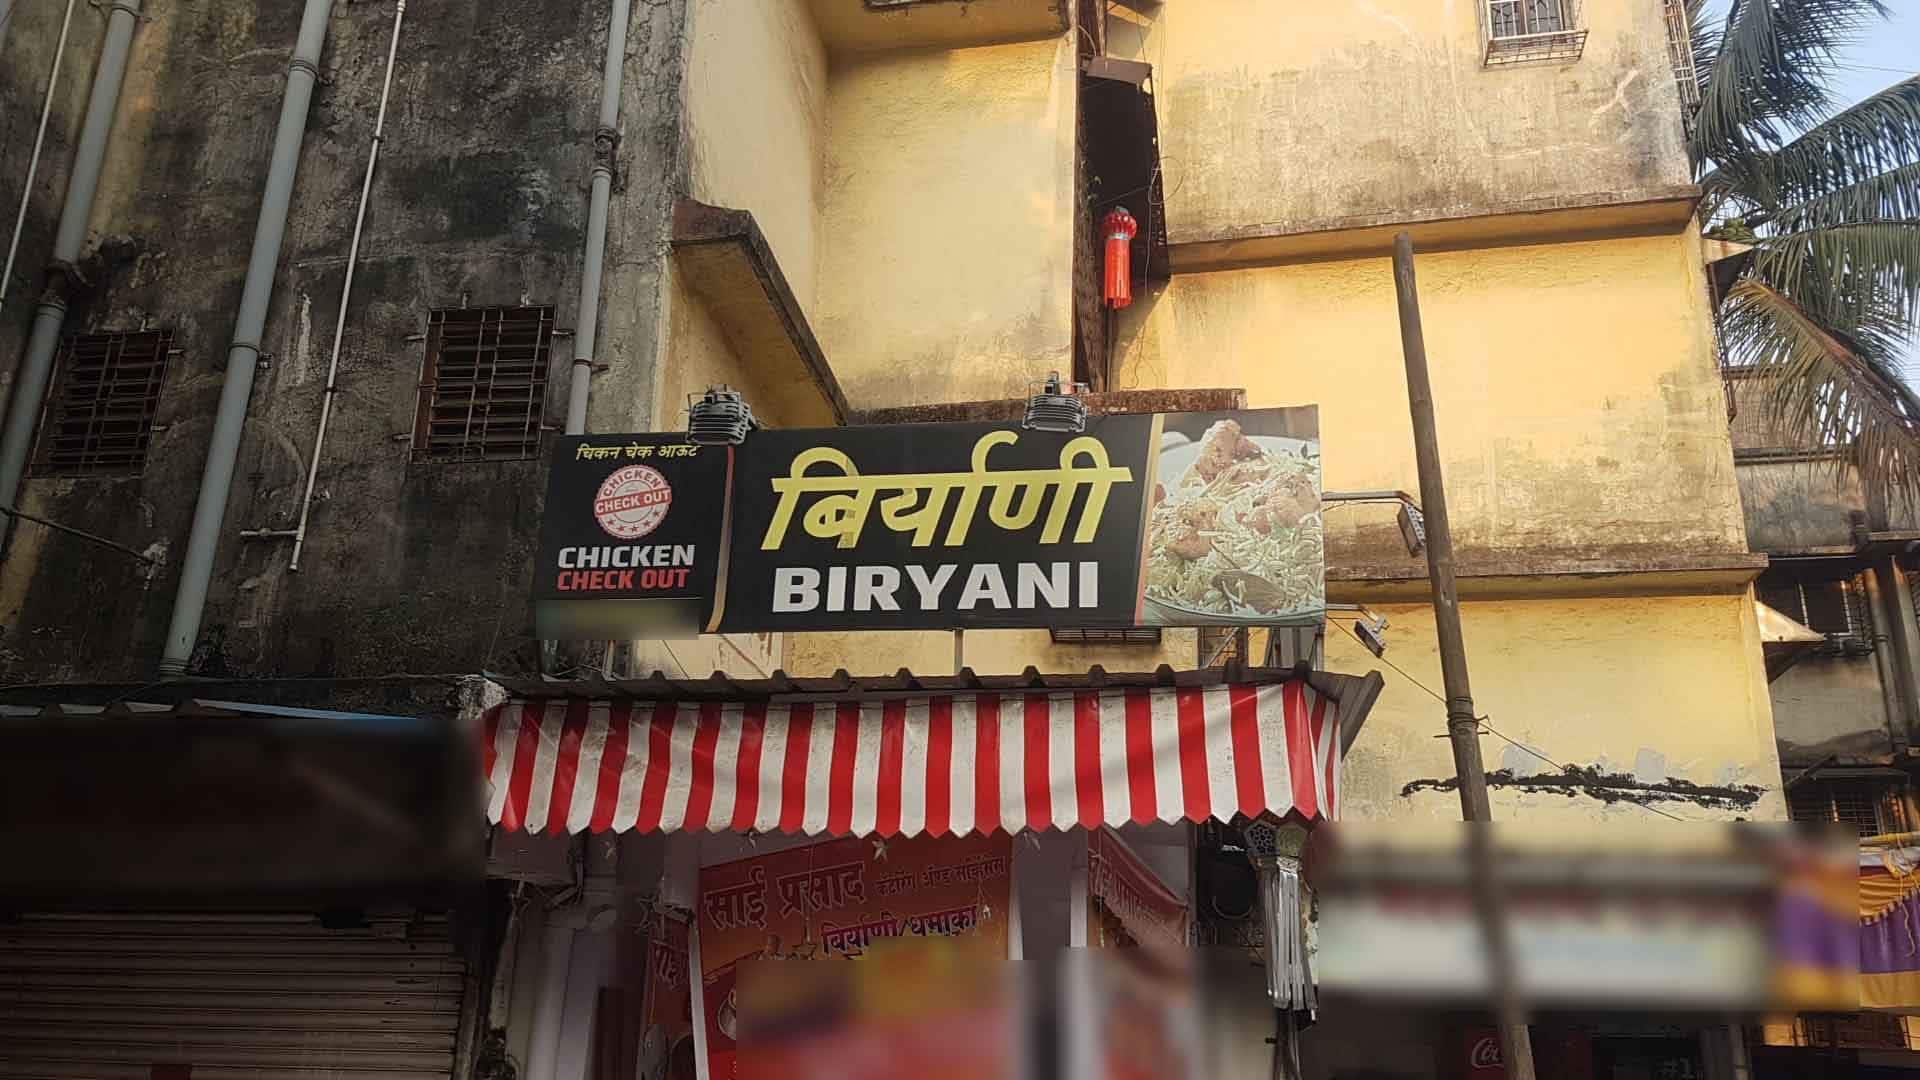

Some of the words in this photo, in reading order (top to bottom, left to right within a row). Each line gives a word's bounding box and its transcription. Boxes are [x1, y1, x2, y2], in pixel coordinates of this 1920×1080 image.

[576, 443, 622, 461] चिकन
[625, 441, 655, 459] चेक
[603, 470, 662, 497] CHICKEN
[761, 430, 1134, 550] बिर्याणी
[596, 495, 641, 513] CHECK
[643, 489, 670, 504] OUT
[558, 545, 696, 568] CHICKEN
[557, 569, 635, 590] CHECK
[640, 569, 691, 588] OUT
[772, 561, 1099, 612] BIRYANI
